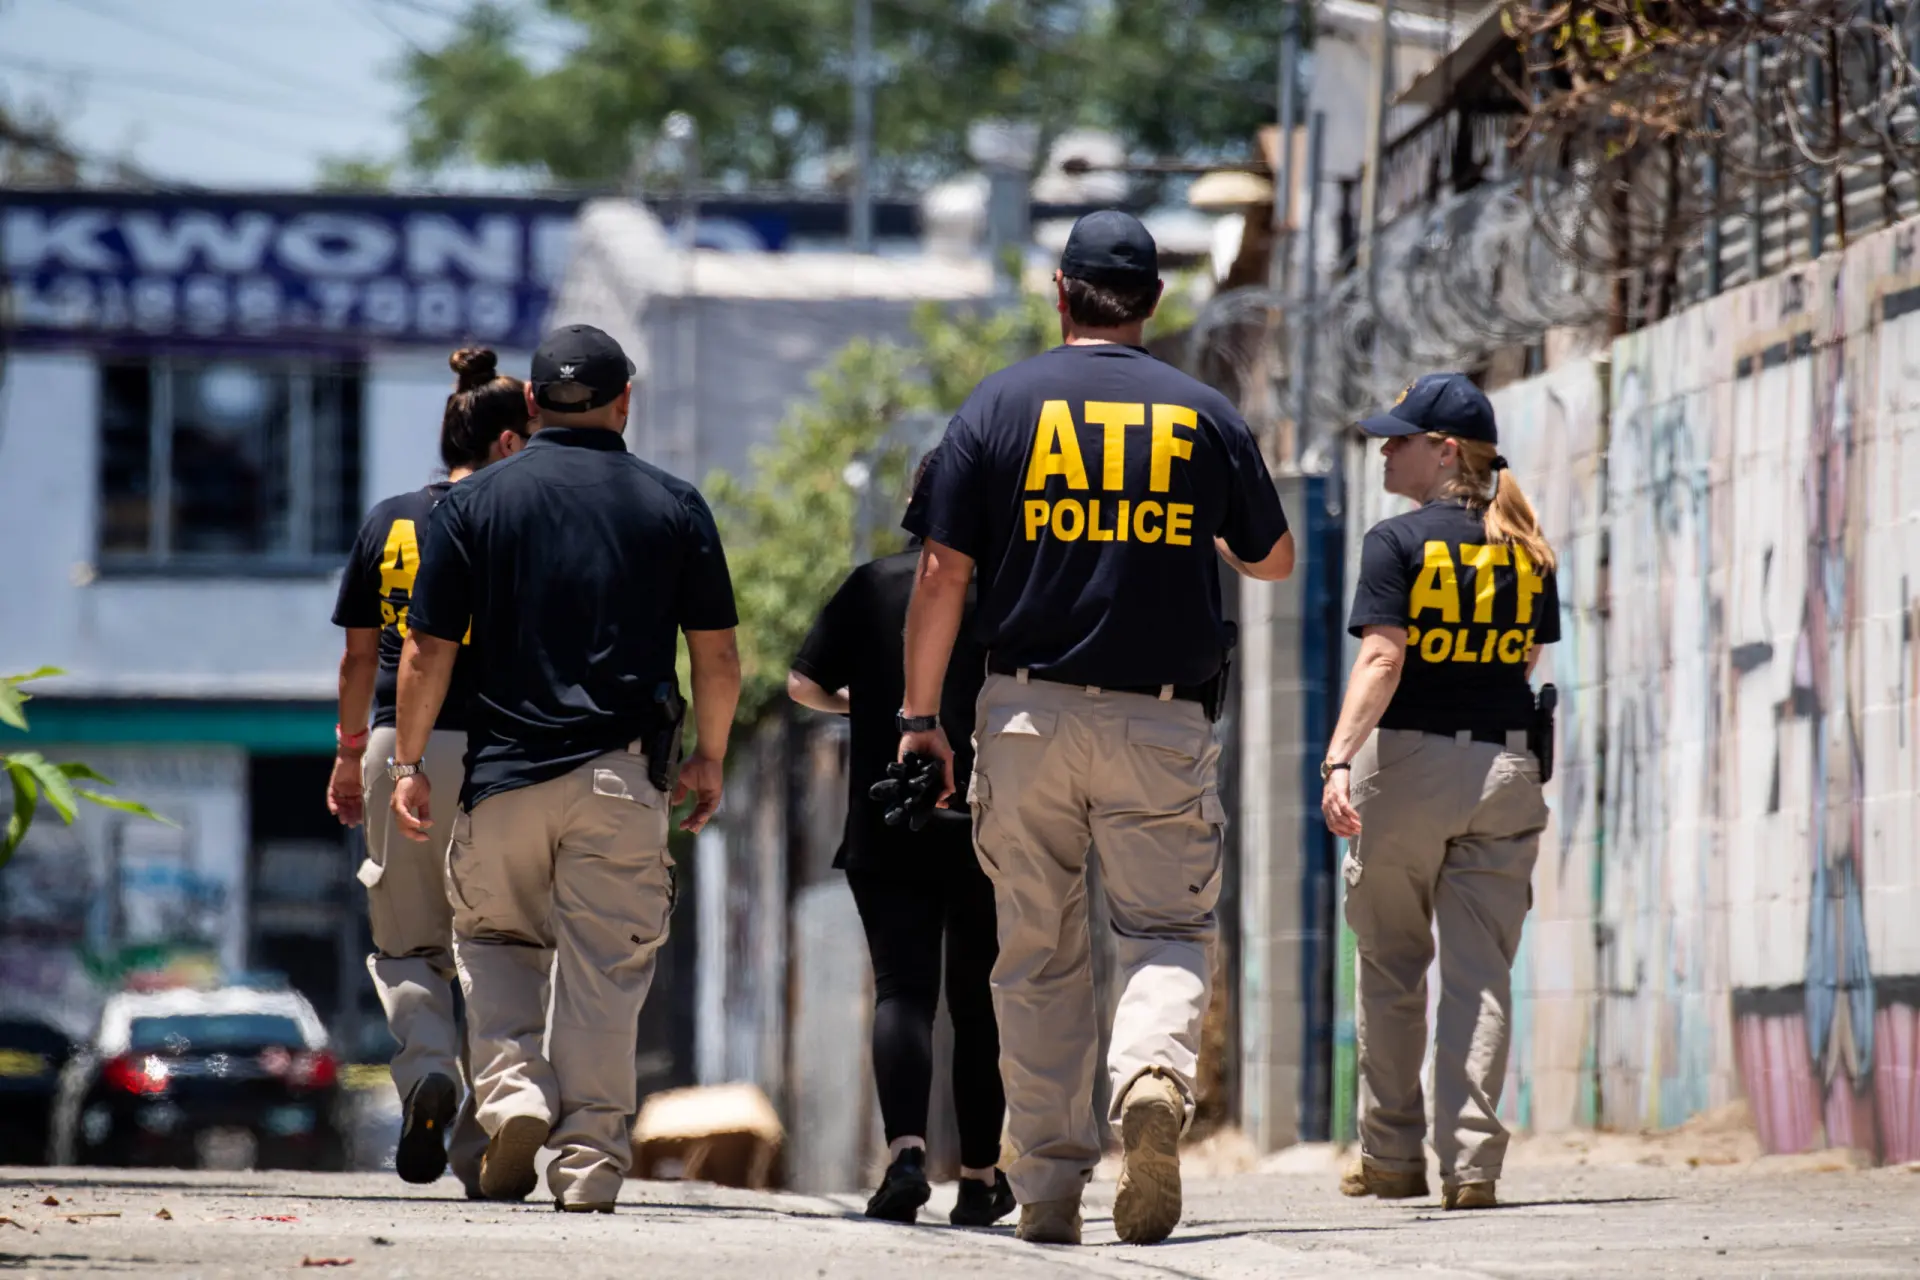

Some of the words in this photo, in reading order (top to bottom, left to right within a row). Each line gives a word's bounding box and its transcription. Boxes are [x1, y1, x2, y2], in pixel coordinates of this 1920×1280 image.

[1024, 400, 1198, 492] ATF
[1024, 499, 1194, 546] POLICE
[1409, 540, 1543, 624] ATF
